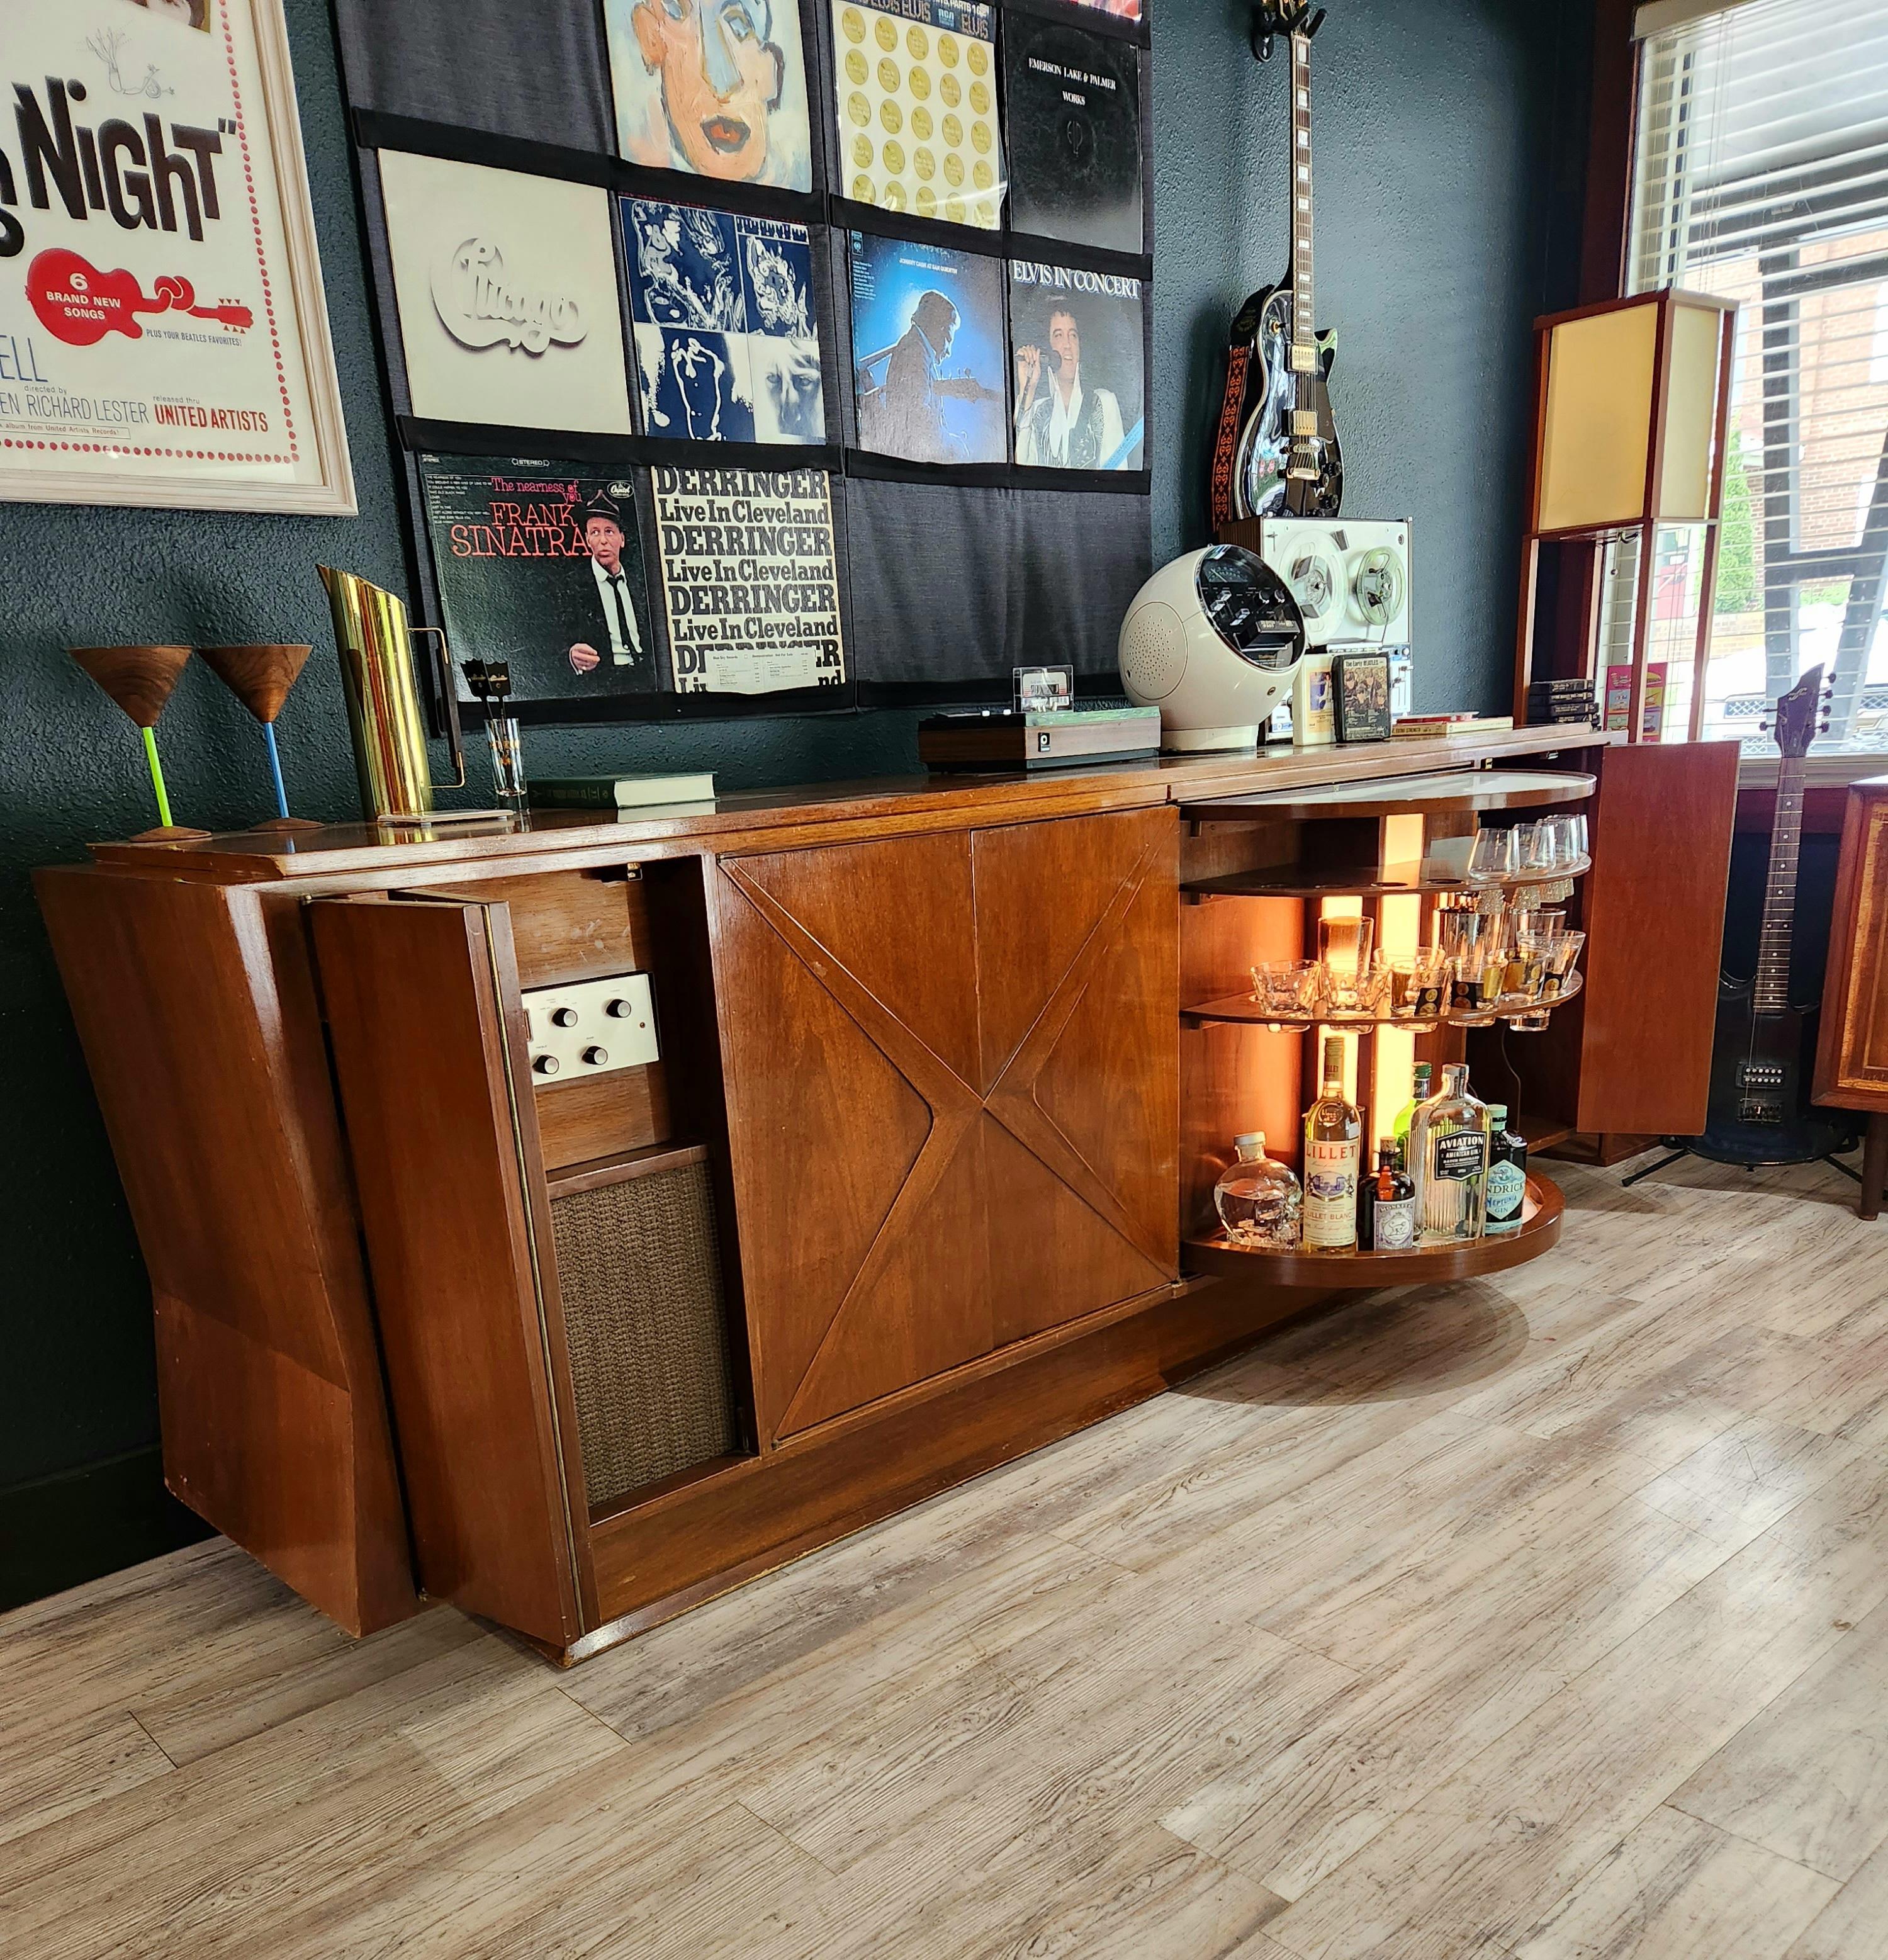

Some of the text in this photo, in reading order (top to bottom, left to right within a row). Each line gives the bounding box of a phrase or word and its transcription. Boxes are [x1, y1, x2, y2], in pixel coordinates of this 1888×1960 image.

[938, 8, 954, 20] RCA
[962, 13, 989, 40] ELVIS
[1028, 57, 1116, 91] EMERSON LAKE & PALMER
[1062, 90, 1086, 106] WORKS
[70, 273, 88, 290] 6
[1012, 259, 1142, 300] ELVIS IN CONCERT
[46, 291, 121, 308] BRAND NEW
[430, 237, 589, 359] Chicago
[64, 307, 106, 320] SONGS
[146, 329, 242, 346] PLUS YOUR BEATLES FAVORITES!
[24, 385, 55, 393] directed
[153, 395, 184, 403] released
[26, 395, 91, 419] RICHARD
[94, 399, 150, 424] LESTER
[154, 404, 269, 432] UNITED ARTISTS
[491, 477, 579, 493] The nearness of
[655, 466, 828, 499] DERRINGER
[562, 493, 582, 506] you
[488, 502, 578, 527] FRANK
[658, 498, 830, 524] Live In Cleveland
[451, 524, 592, 556] SINATRA
[661, 524, 833, 556] DERRINGER
[665, 558, 834, 582] Live In Cleveland
[668, 583, 837, 616] DERRINGER
[672, 615, 839, 641] Live In Cleveland
[1306, 1144, 1356, 1159] LILLET
[1439, 1135, 1483, 1150] AVIATION
[1446, 1150, 1470, 1158] AMERICAN
[1307, 1210, 1327, 1220] LILLET
